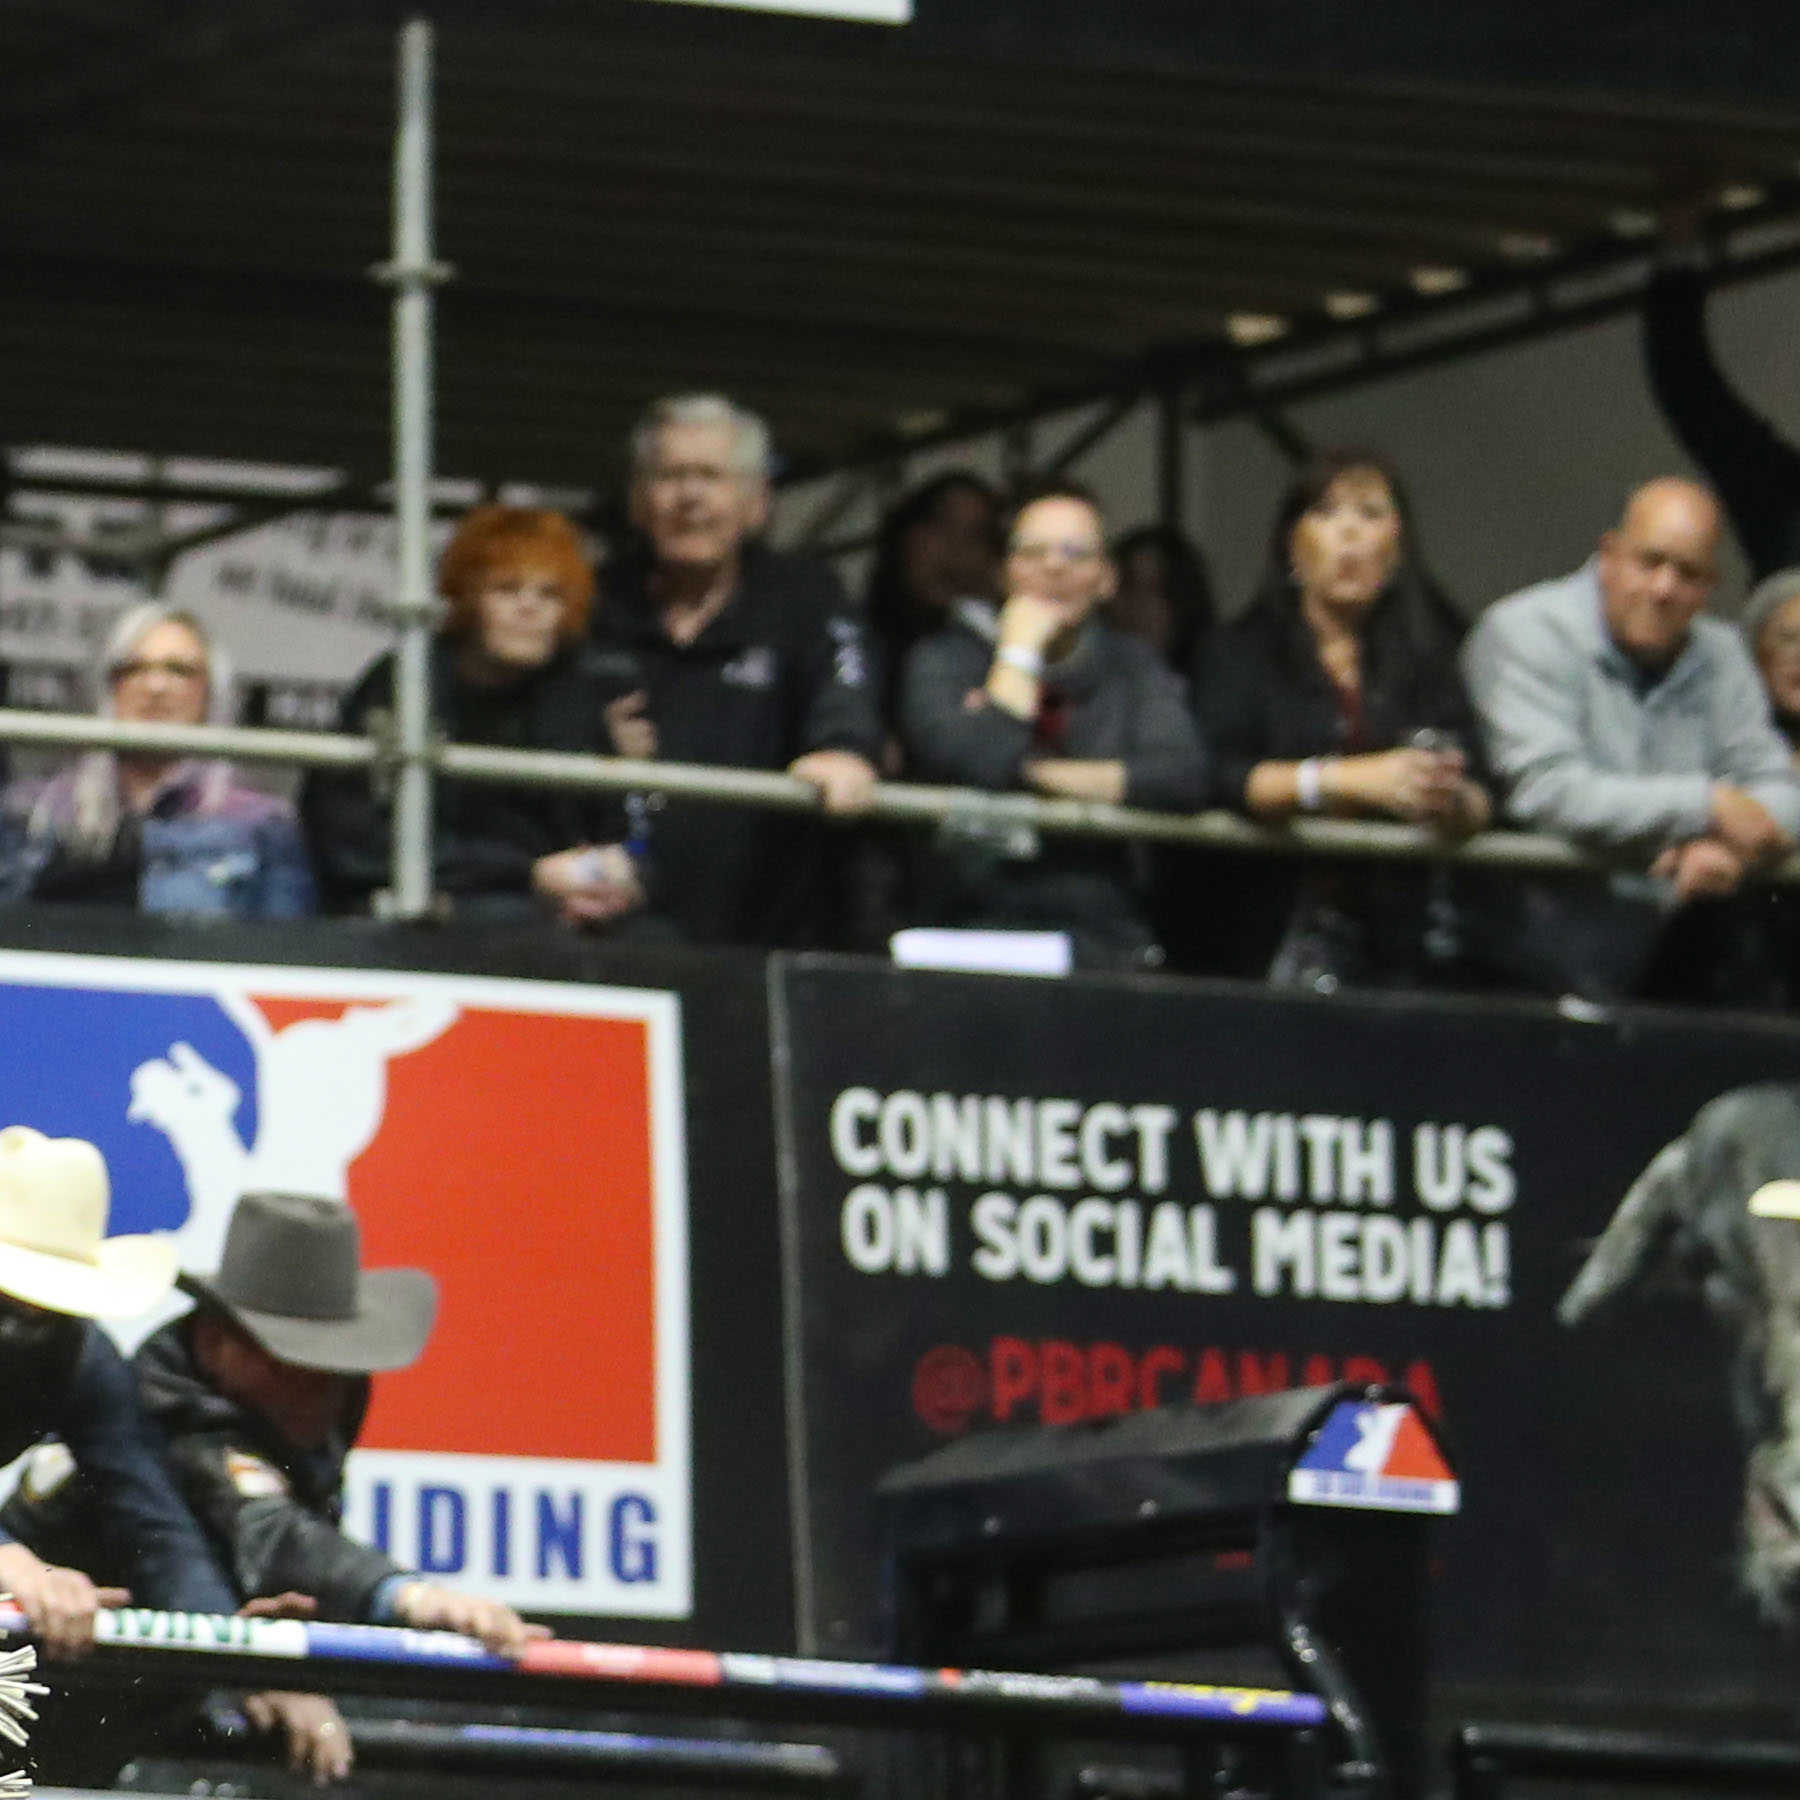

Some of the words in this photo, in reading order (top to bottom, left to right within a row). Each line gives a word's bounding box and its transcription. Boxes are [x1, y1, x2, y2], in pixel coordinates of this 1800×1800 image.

[829, 1086, 1176, 1194] CONNECT
[1192, 1107, 1396, 1204] WITH
[1412, 1120, 1517, 1212] US
[840, 1183, 949, 1277] ON
[970, 1192, 1235, 1294] SOCIAL
[1250, 1205, 1513, 1309] MEDIA!
[371, 1479, 657, 1584] IDING
